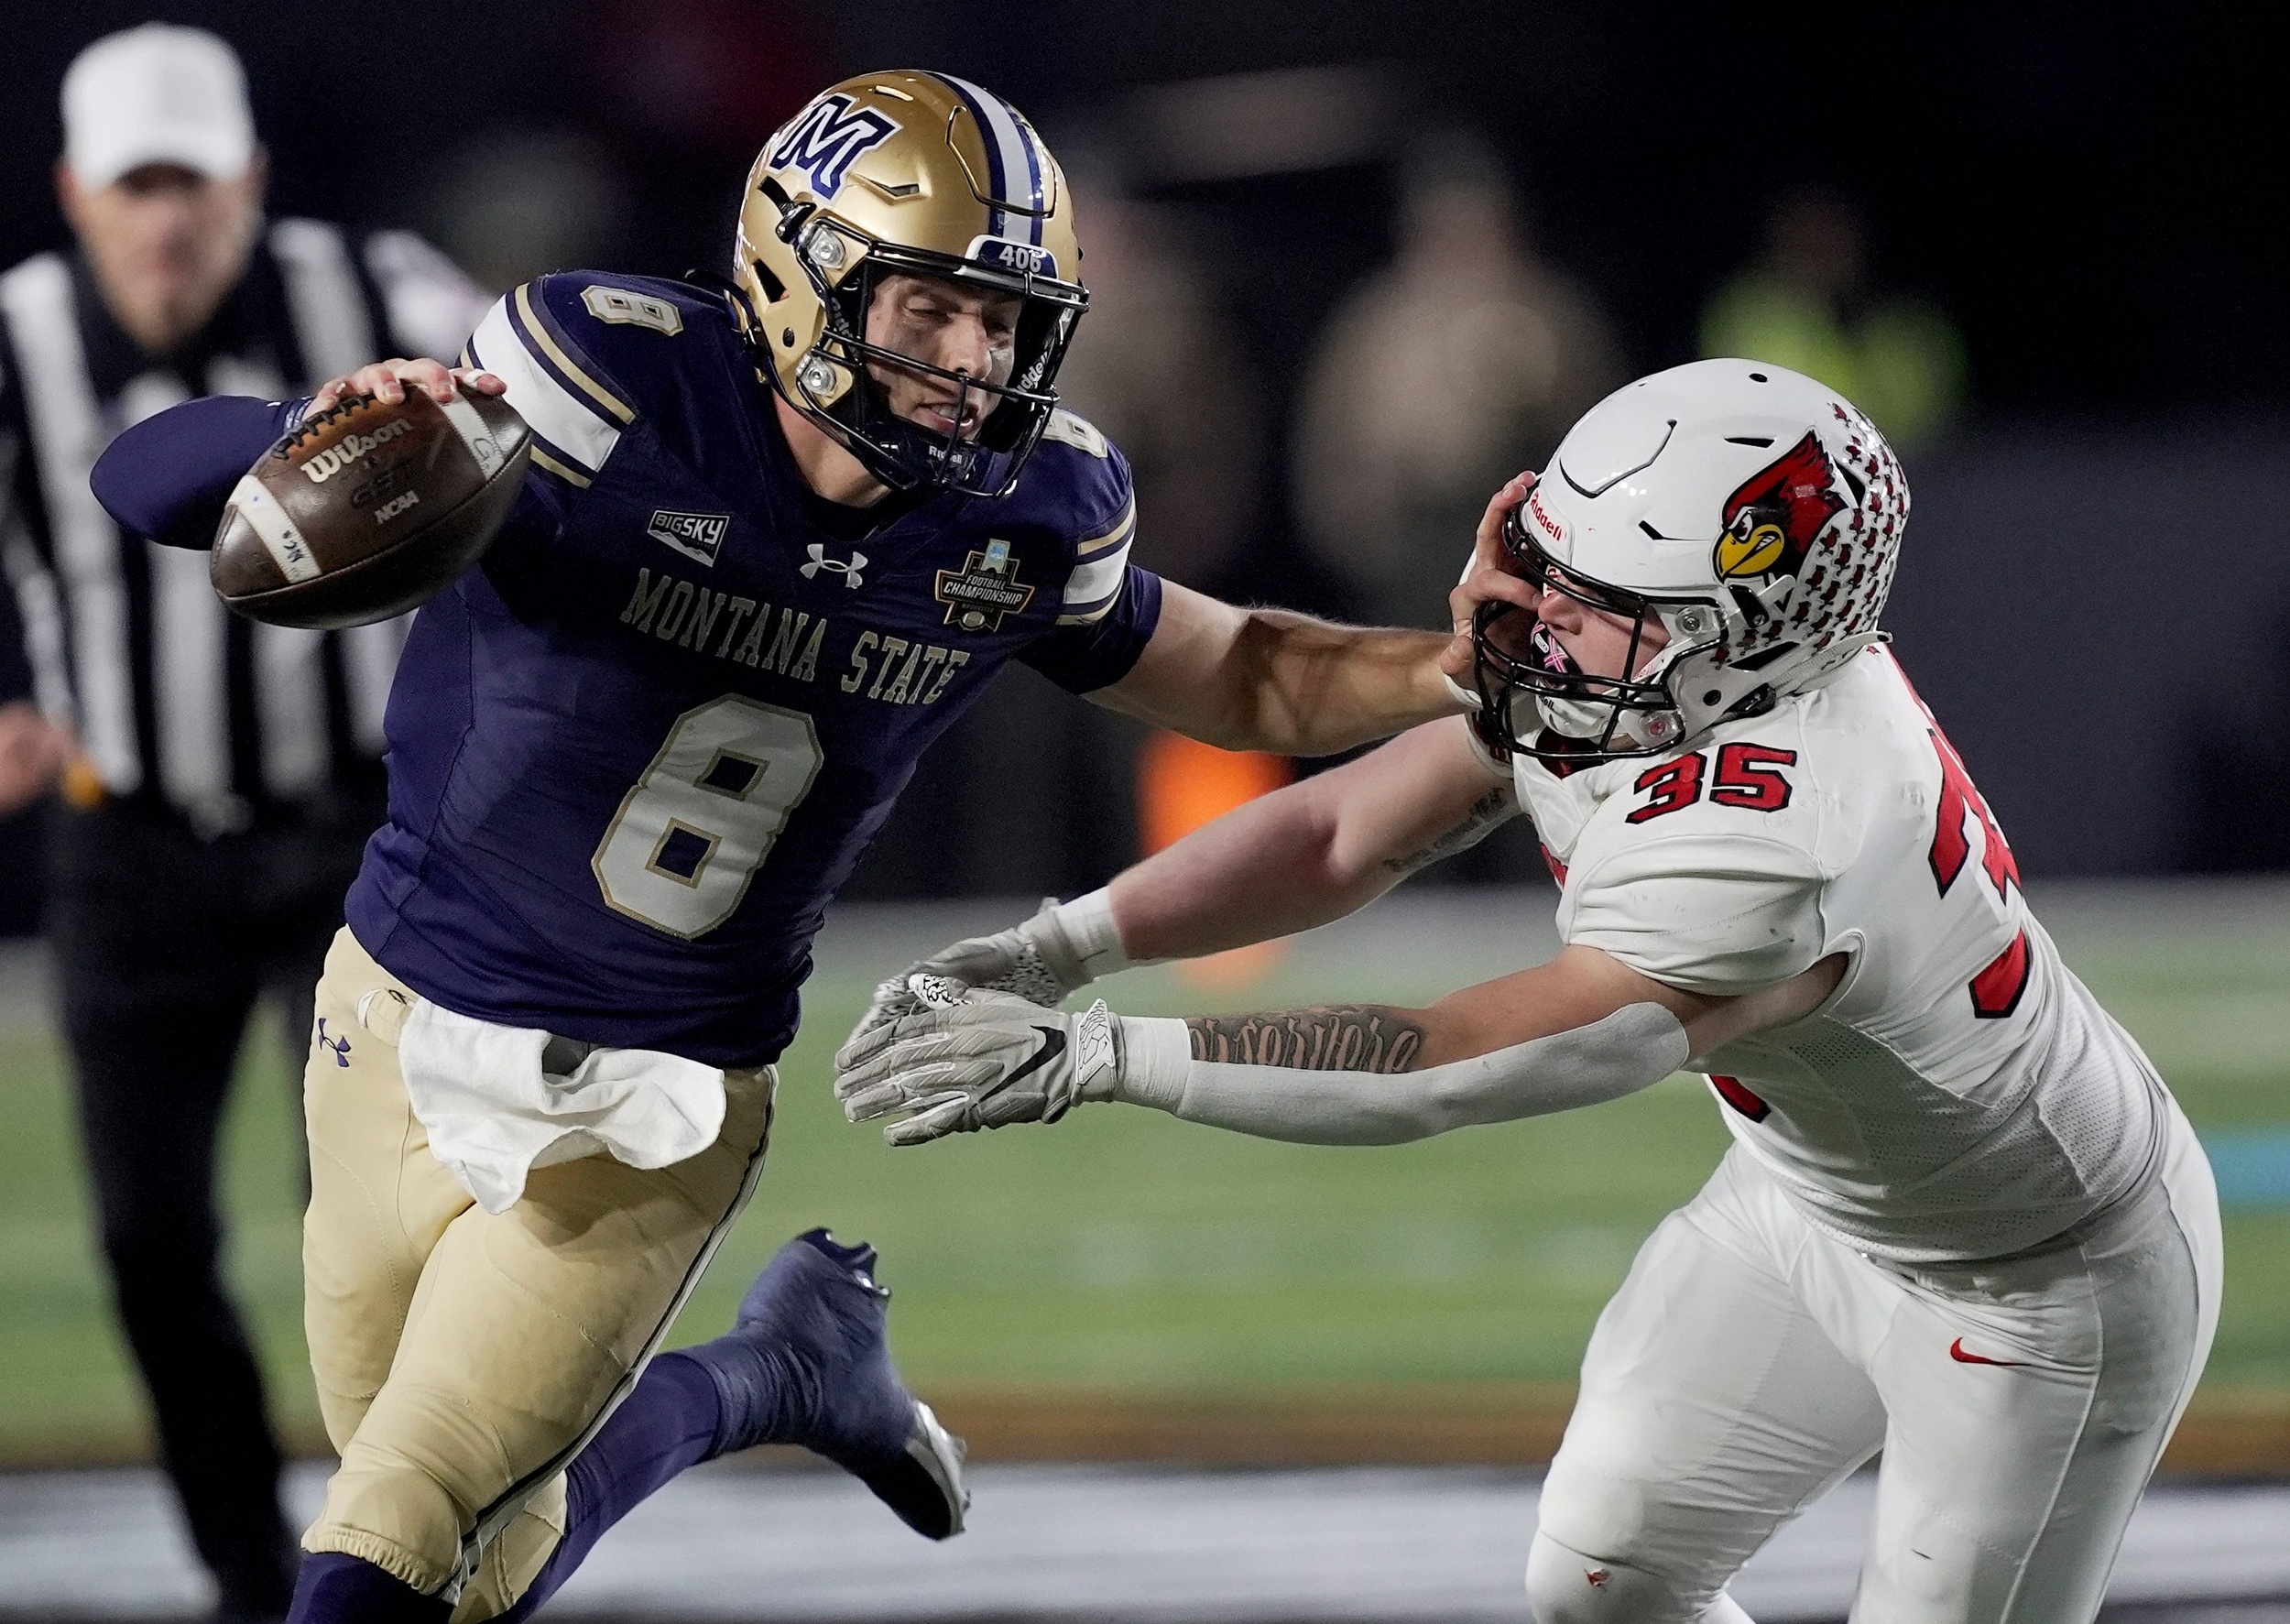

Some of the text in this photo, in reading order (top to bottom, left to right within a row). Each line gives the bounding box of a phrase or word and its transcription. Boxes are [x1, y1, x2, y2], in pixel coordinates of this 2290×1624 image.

[765, 93, 904, 203] M
[998, 245, 1041, 273] 406
[580, 285, 684, 336] 8
[300, 418, 414, 483] Wilson
[928, 444, 963, 464] Ridell
[375, 490, 420, 524] NCAA
[943, 581, 1024, 605] CHAMPIONSHIP
[965, 574, 1007, 591] FOOTBALL
[619, 567, 971, 705] MONTANA STATE
[1625, 741, 1797, 825] 35
[590, 692, 825, 943] 8
